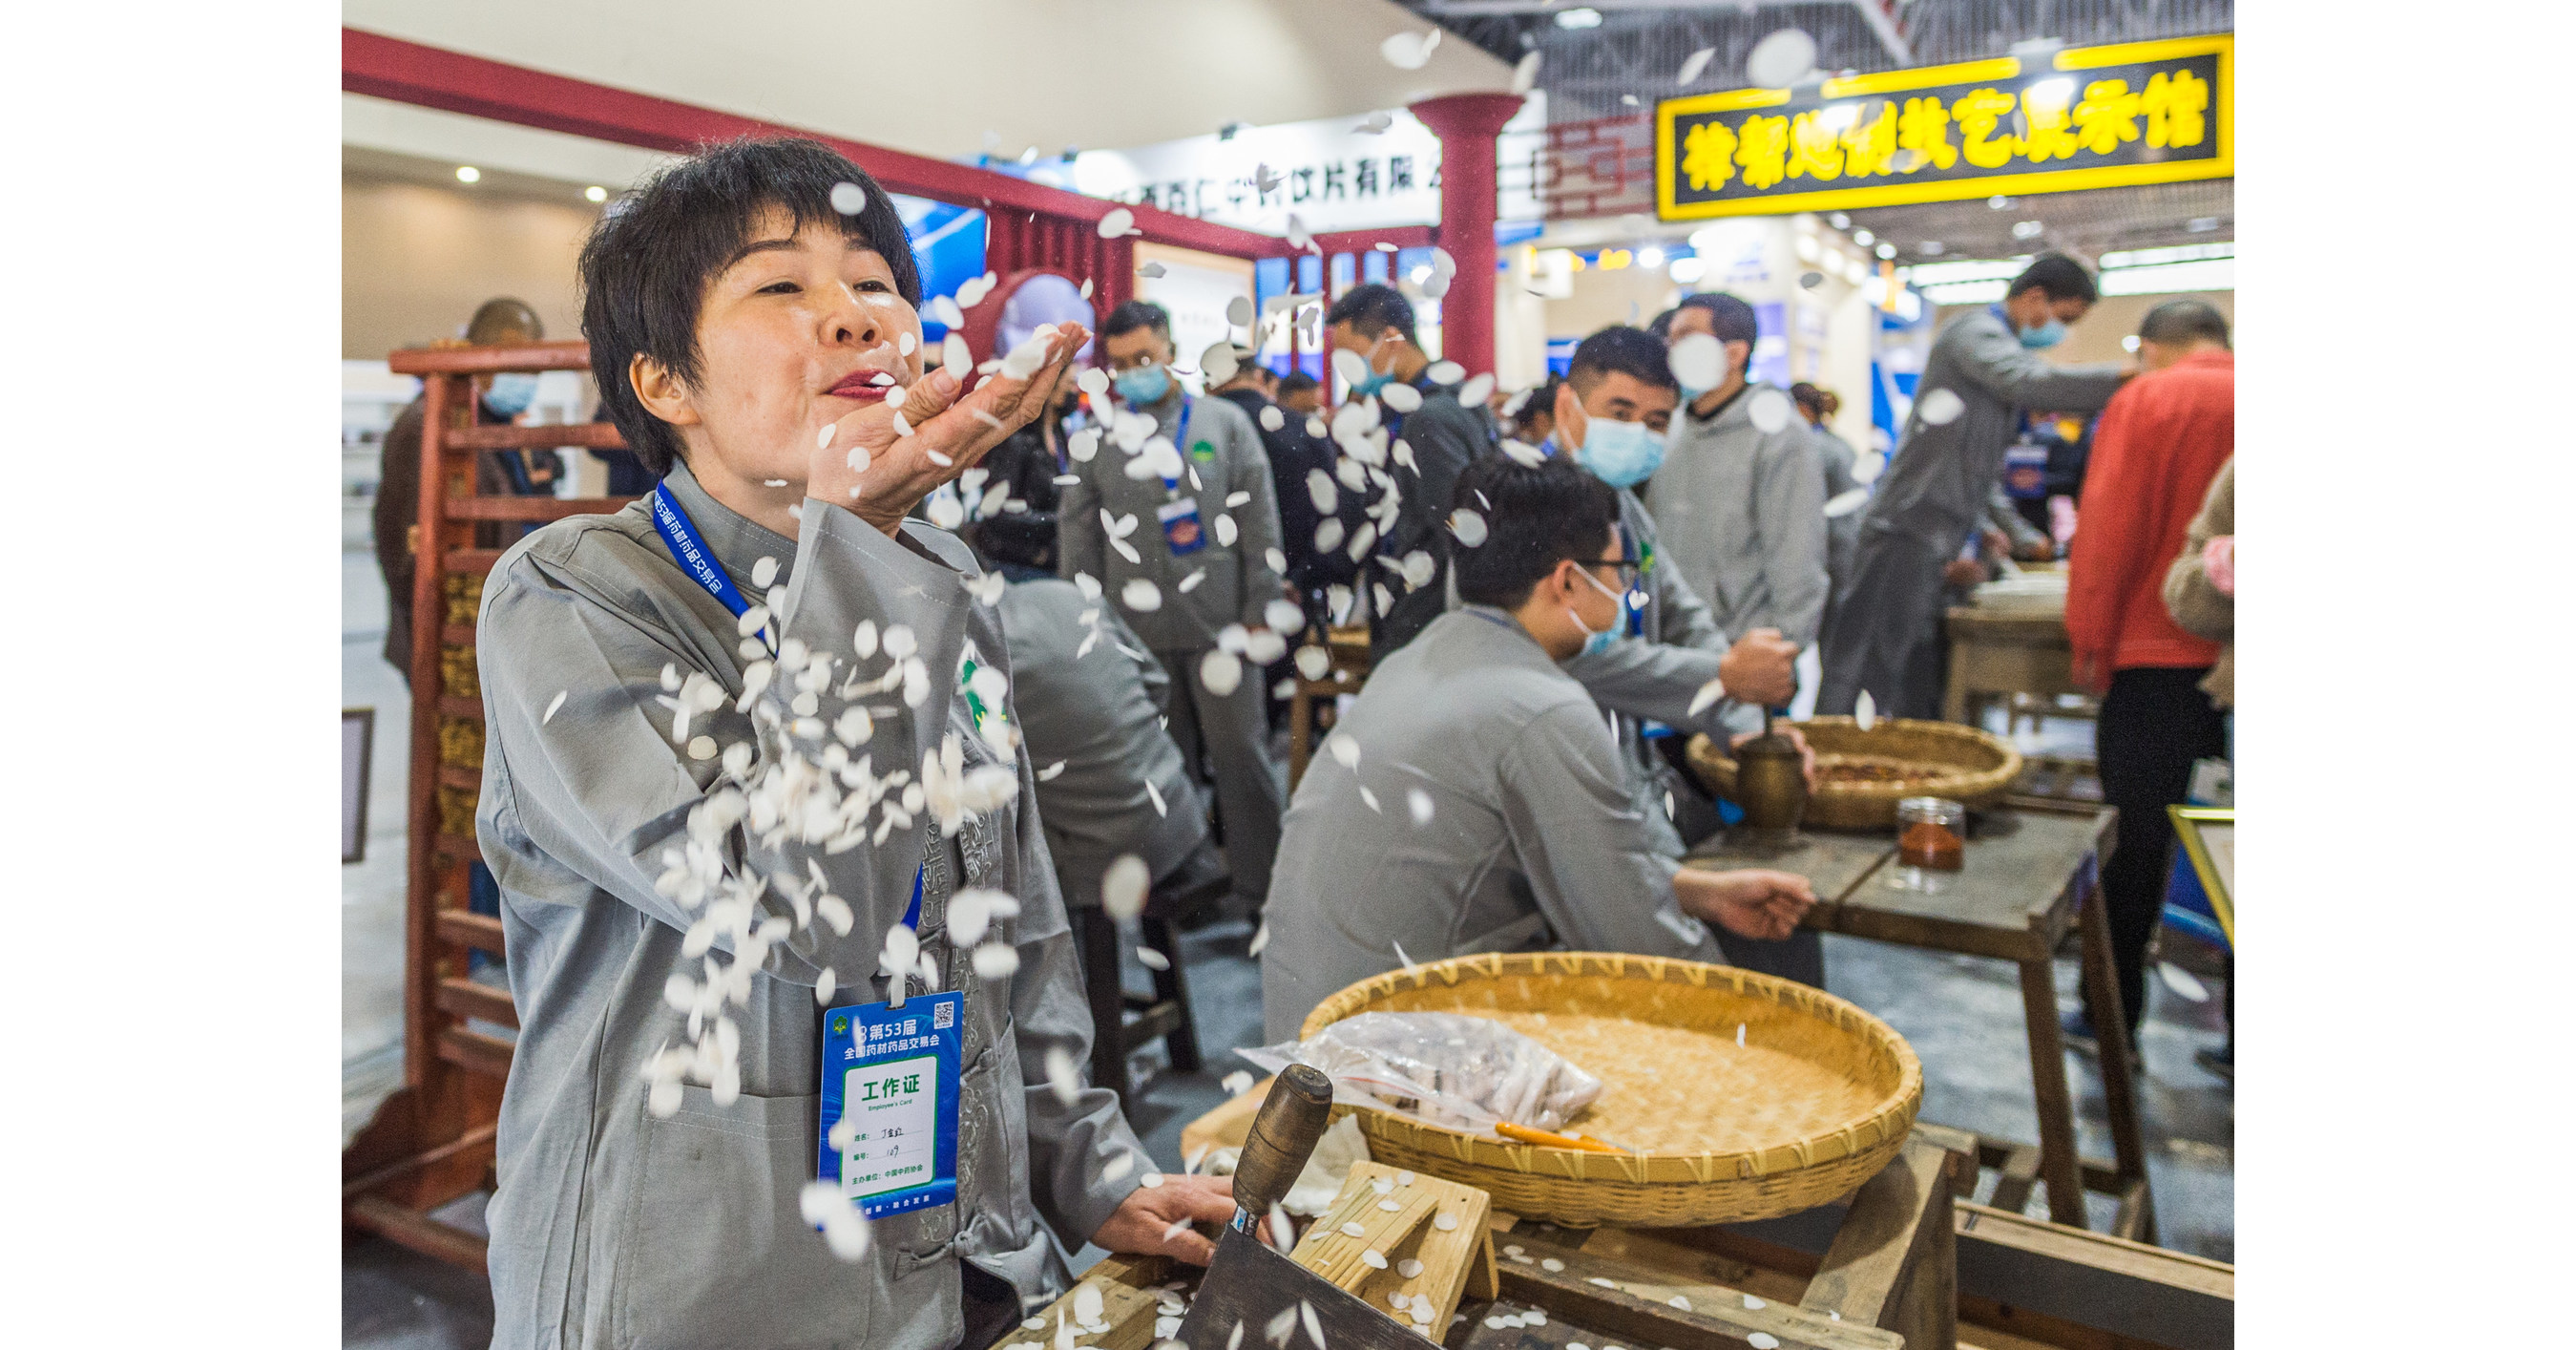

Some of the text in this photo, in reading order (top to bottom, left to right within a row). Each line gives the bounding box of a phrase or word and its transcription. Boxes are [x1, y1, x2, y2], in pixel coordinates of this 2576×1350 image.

[844, 1034, 940, 1060] 全国药材药品交易会
[861, 1073, 920, 1102] 工作证
[868, 1101, 898, 1111] Employee's
